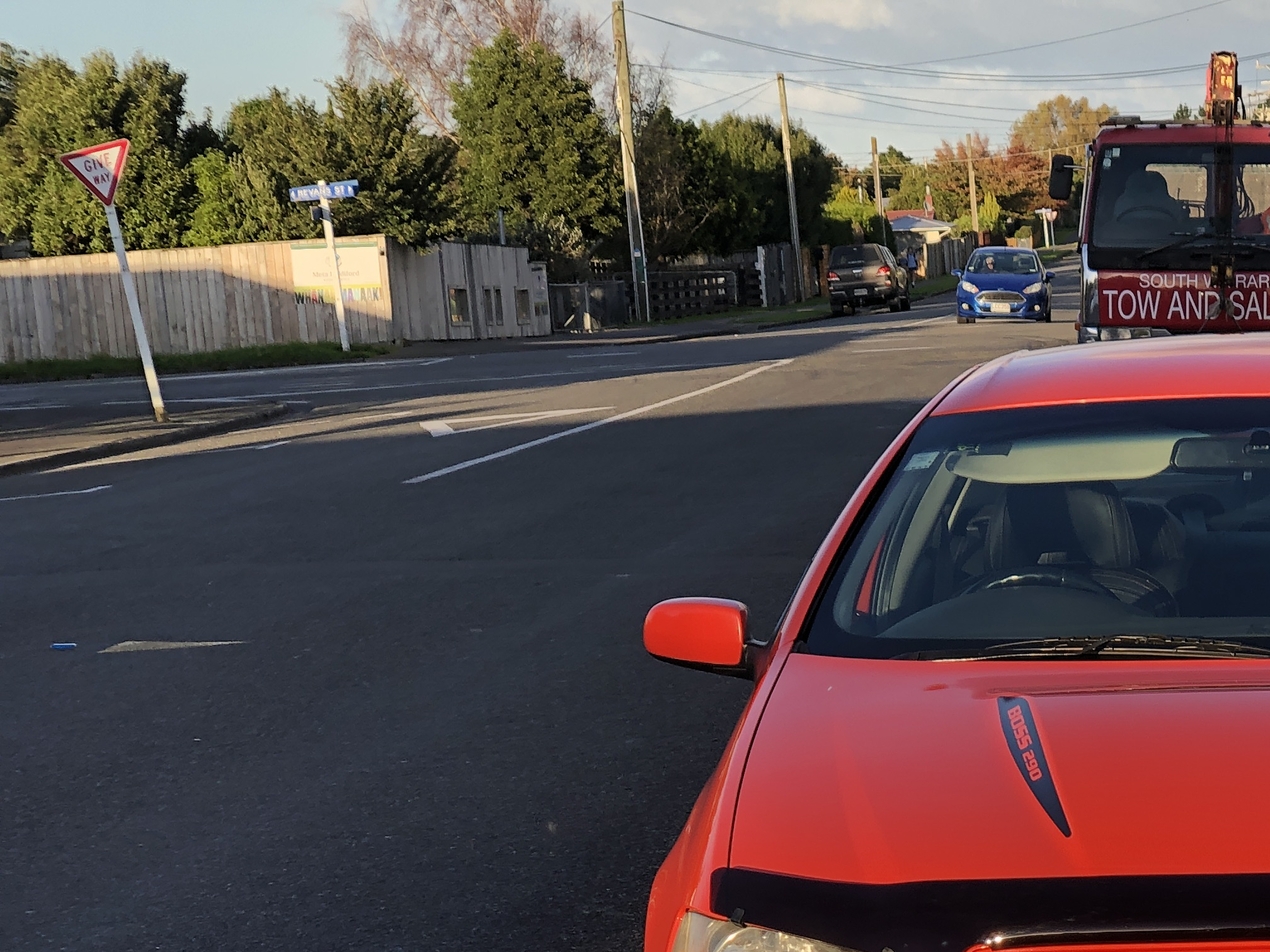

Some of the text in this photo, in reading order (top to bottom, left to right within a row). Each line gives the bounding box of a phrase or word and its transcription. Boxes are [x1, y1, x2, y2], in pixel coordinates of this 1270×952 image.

[83, 152, 111, 173] GIVE
[92, 172, 110, 185] WAY
[334, 185, 345, 195] ST
[1139, 273, 1198, 289] SOUTH
[1102, 290, 1160, 320] TOW
[1167, 290, 1221, 320] AND
[1007, 704, 1043, 782] BOSS 290
